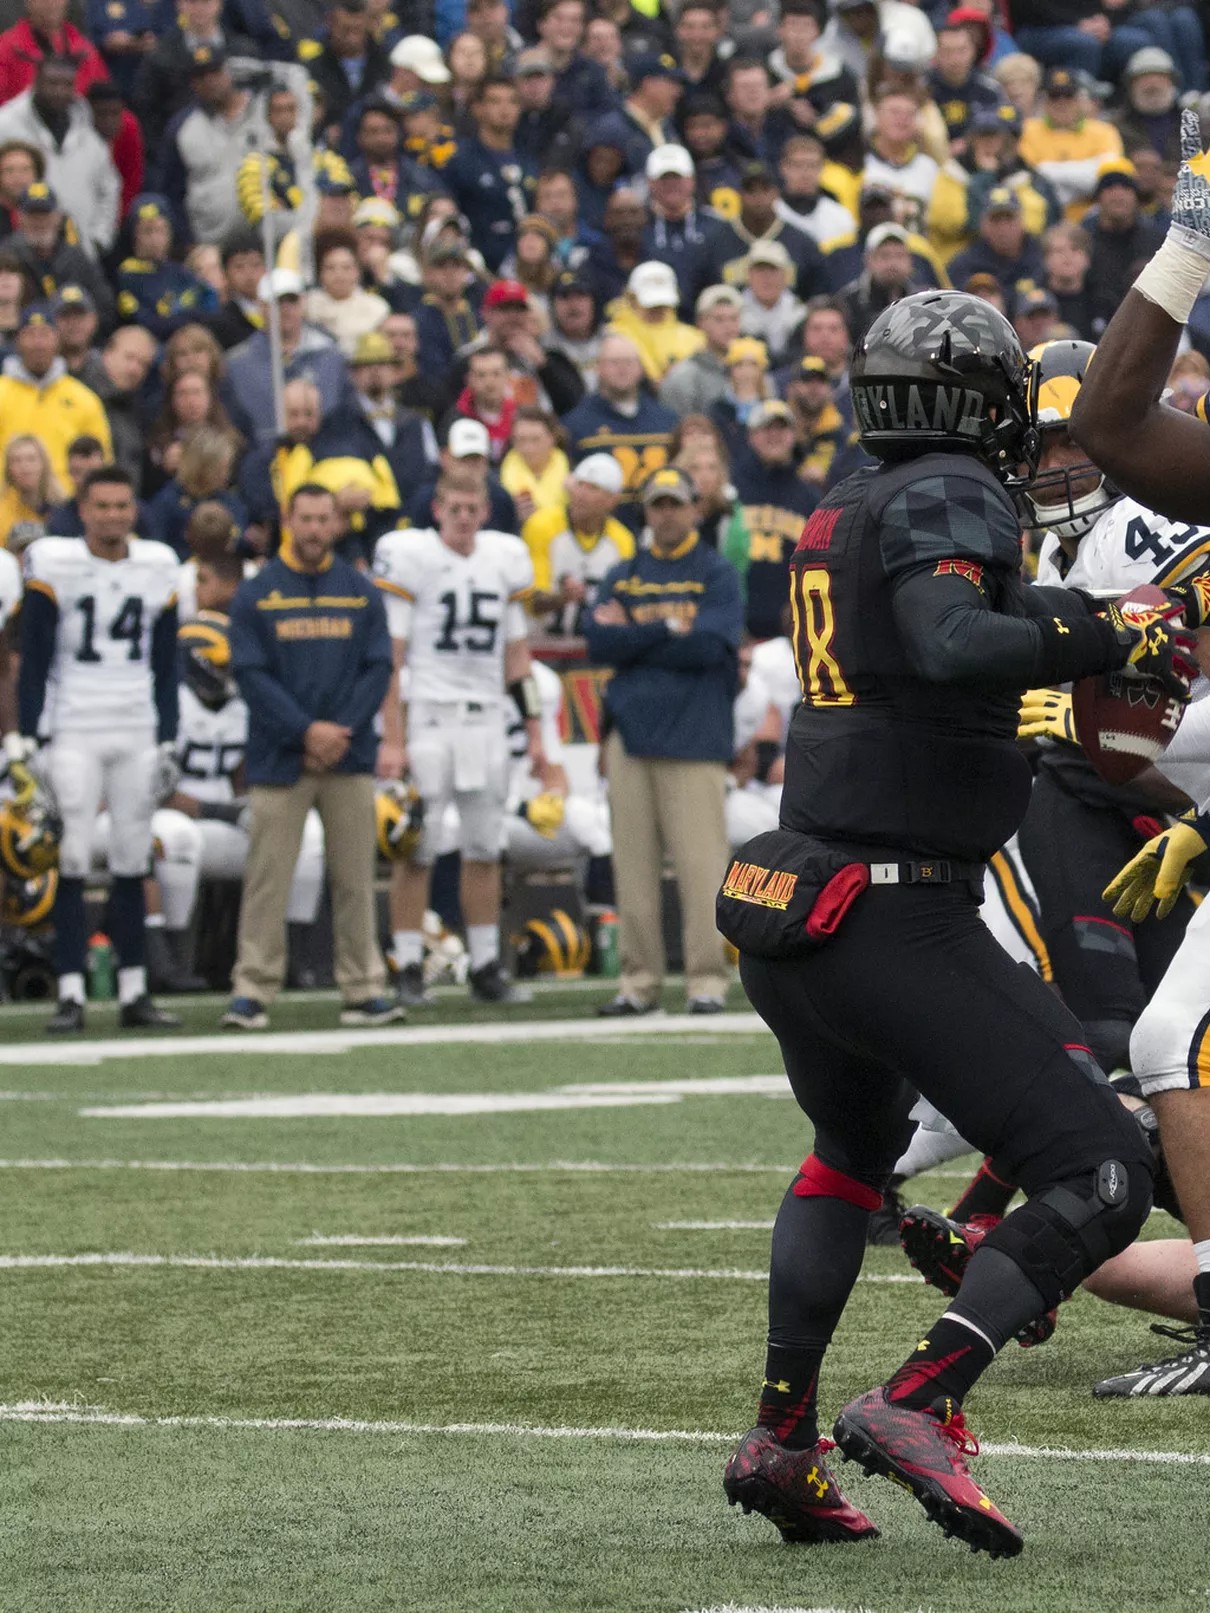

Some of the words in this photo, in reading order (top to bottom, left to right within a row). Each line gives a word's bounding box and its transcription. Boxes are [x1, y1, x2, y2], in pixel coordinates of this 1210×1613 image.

[75, 595, 144, 662] 14
[435, 592, 499, 651] 15
[723, 861, 798, 903] MARYLAND
